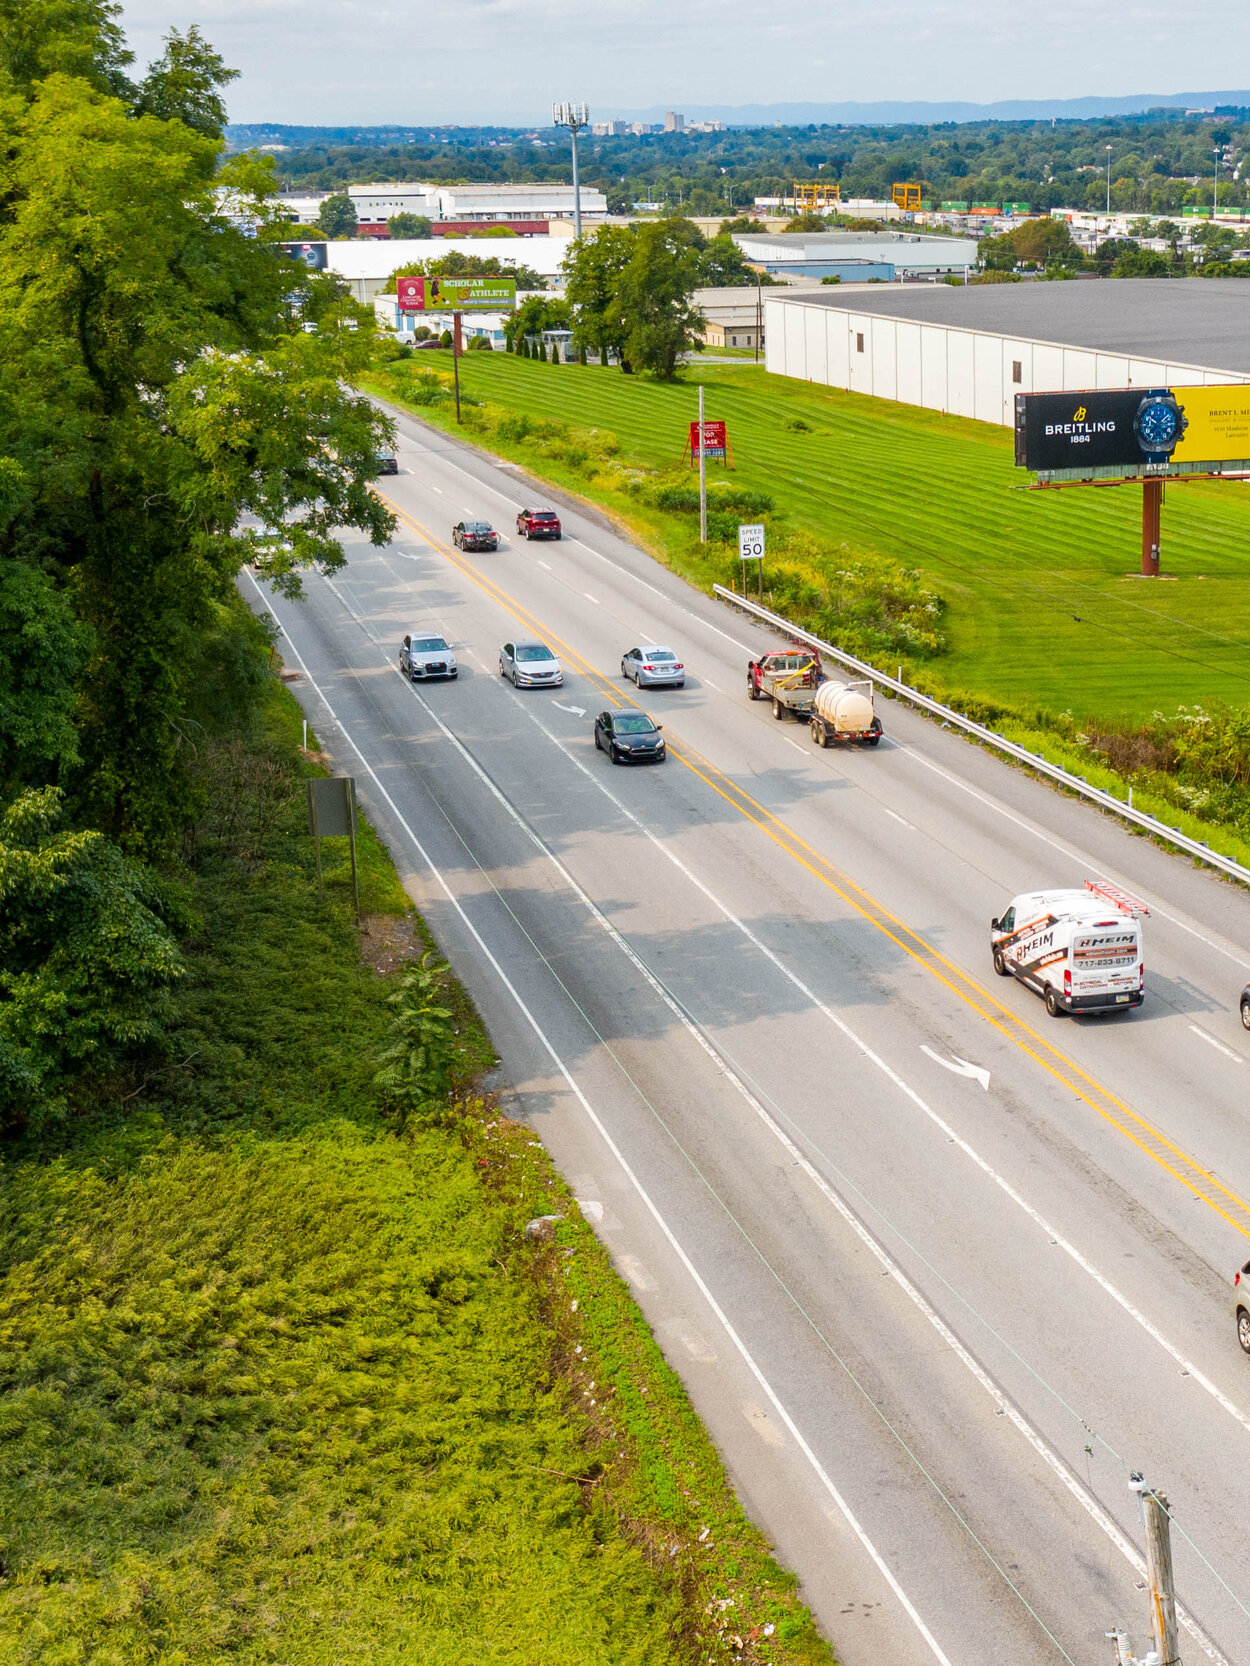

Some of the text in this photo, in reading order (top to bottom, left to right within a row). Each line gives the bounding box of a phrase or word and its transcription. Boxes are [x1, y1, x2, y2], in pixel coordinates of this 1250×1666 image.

[469, 289, 510, 297] ATHLETE
[1045, 421, 1116, 435] BREITLING
[1070, 435, 1091, 443] 1884
[742, 543, 762, 556] 50
[1023, 932, 1054, 958] HEIM
[1092, 935, 1135, 946] HEIM
